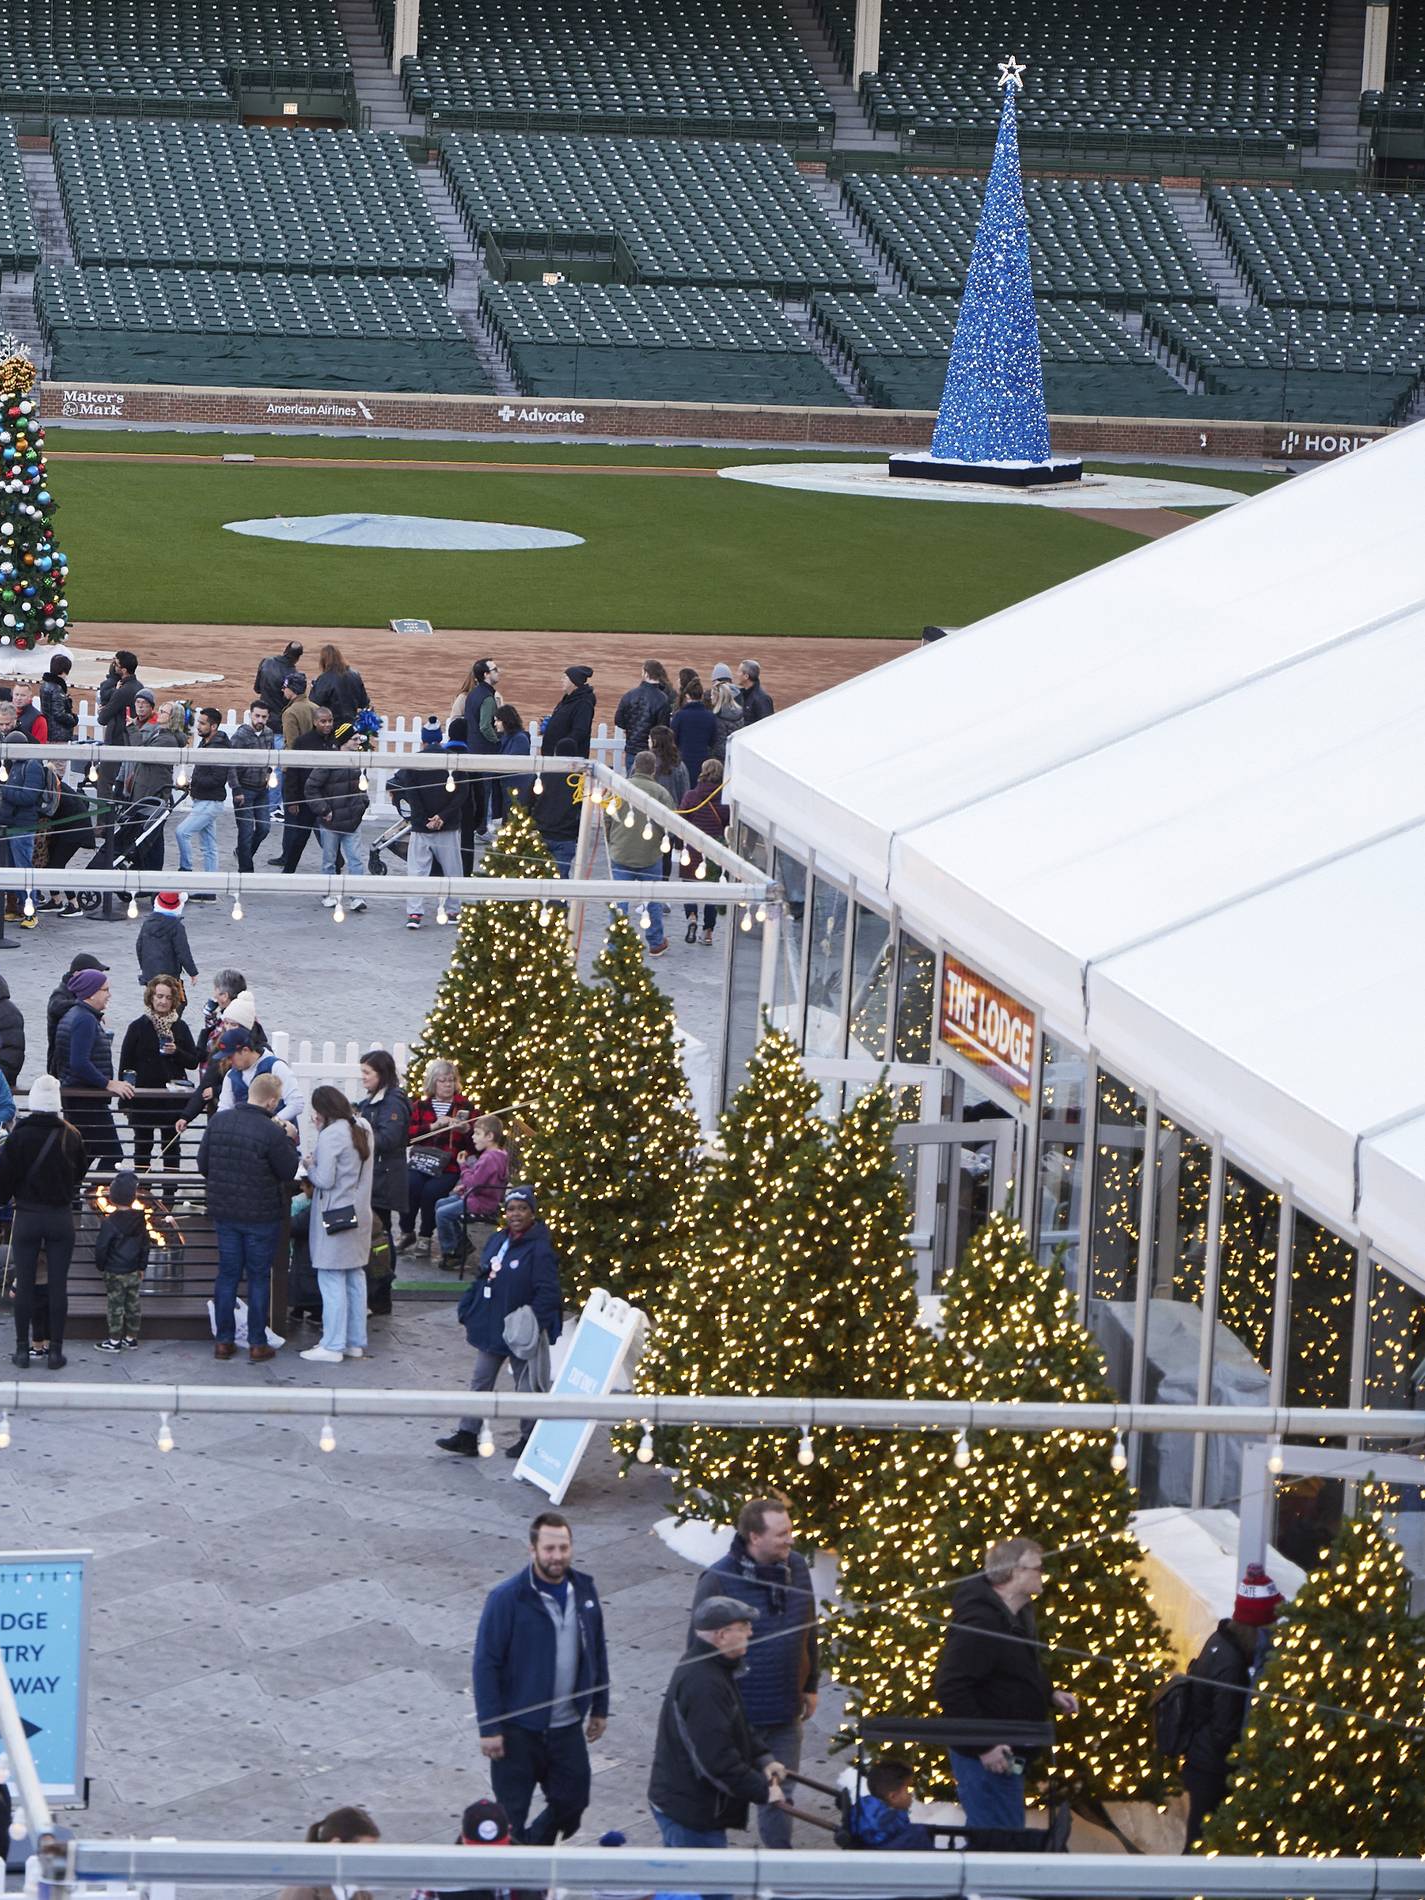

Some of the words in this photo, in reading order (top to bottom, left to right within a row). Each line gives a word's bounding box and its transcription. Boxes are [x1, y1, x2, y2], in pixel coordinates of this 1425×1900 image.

[63, 390, 124, 404] Maker's
[79, 403, 123, 416] Mark
[266, 403, 316, 414] American
[317, 404, 357, 416] Airlines
[518, 407, 585, 423] Advocate
[948, 970, 977, 1031] THE
[978, 993, 1032, 1073] LODGE
[9, 1676, 61, 1695] WAY
